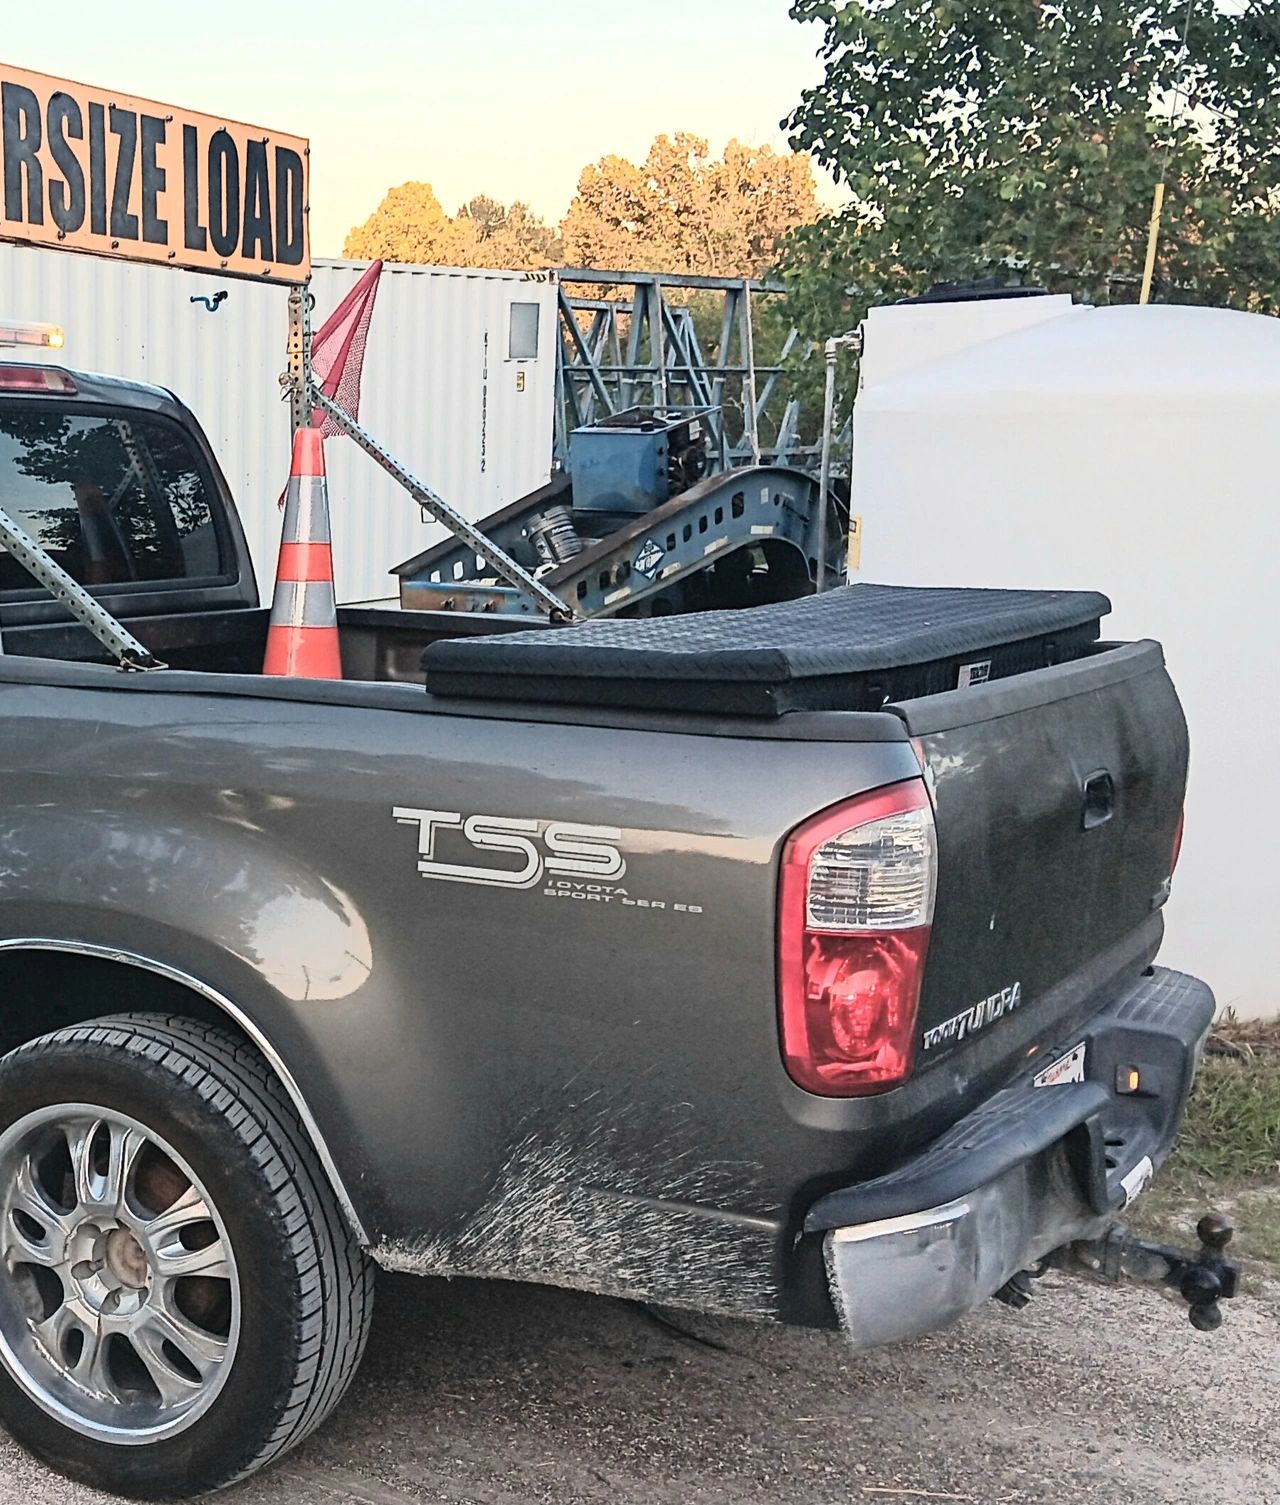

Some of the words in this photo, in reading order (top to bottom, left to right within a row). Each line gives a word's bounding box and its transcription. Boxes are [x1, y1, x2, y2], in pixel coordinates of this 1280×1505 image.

[182, 123, 305, 266] LOAD
[392, 806, 627, 890] TSS
[543, 888, 614, 903] SPORT
